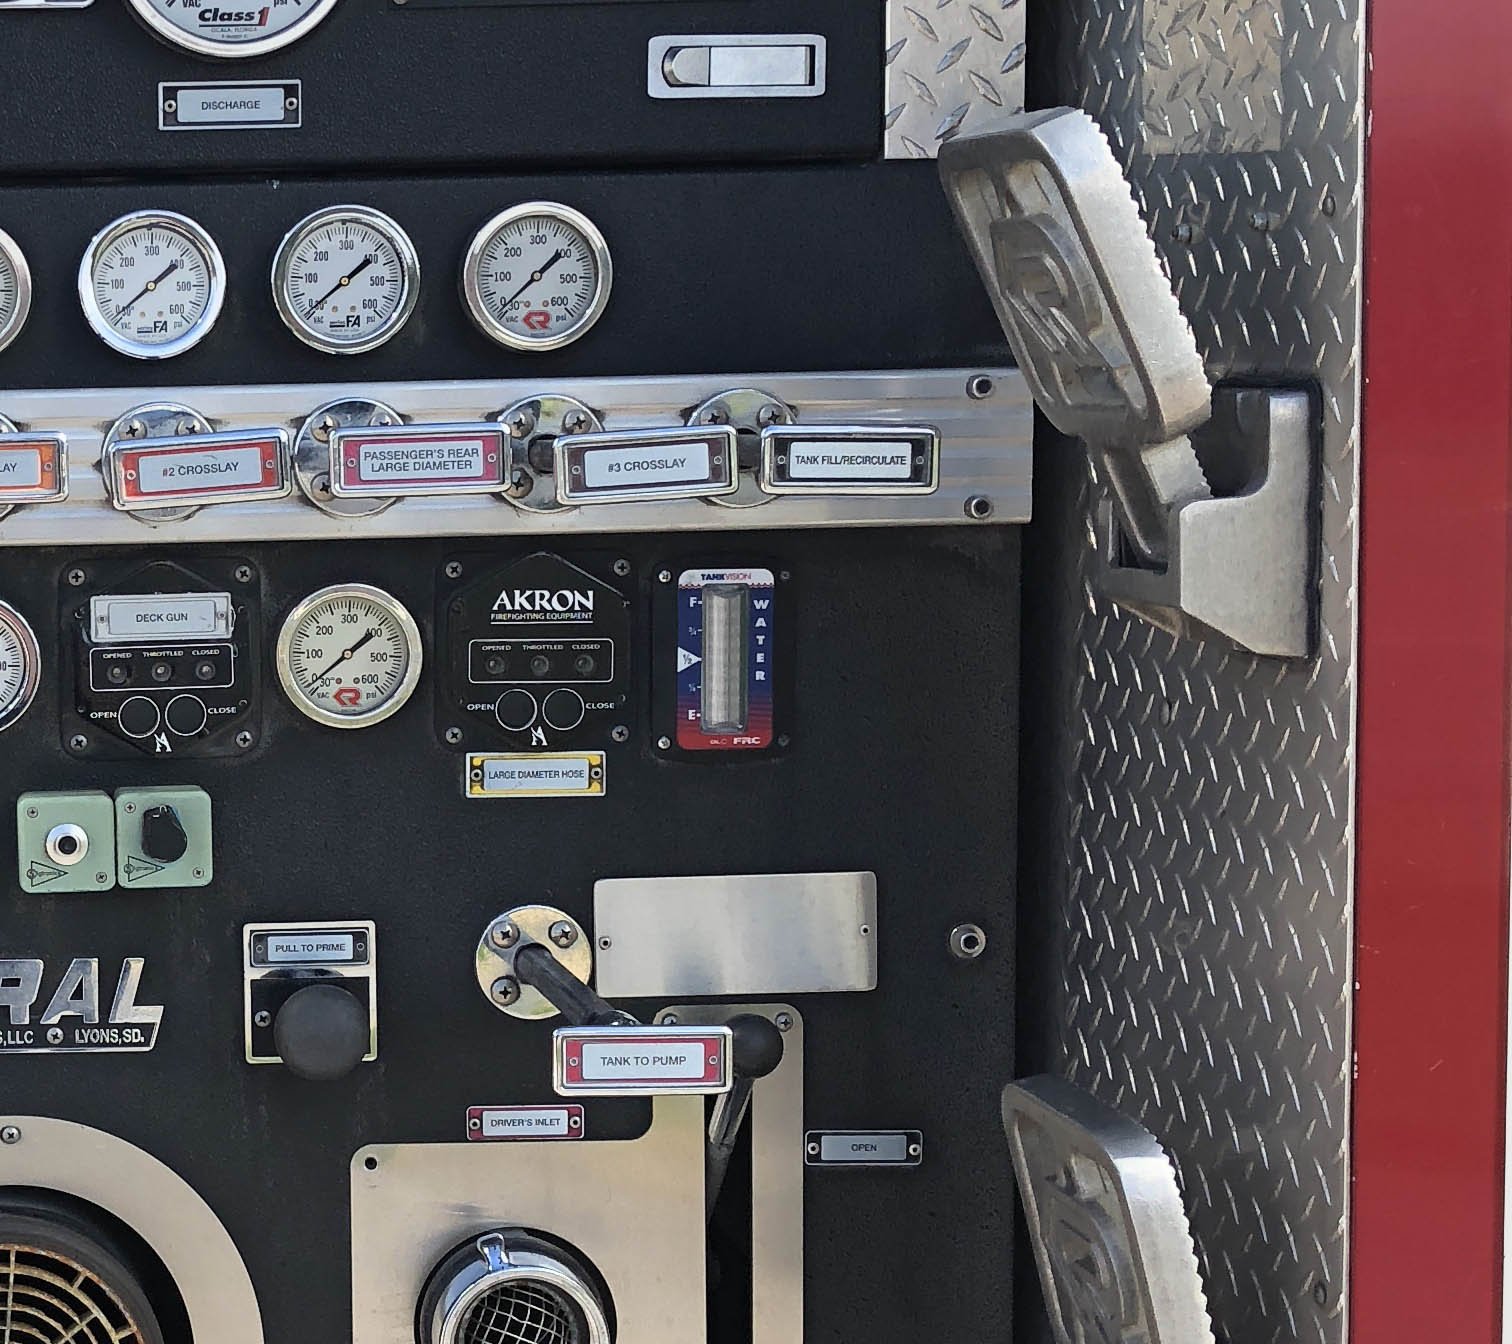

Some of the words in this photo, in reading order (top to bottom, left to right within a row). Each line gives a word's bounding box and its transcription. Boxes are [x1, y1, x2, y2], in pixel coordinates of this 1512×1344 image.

[199, 7, 270, 26] Class1
[201, 101, 261, 110] DISCHARGE
[529, 234, 547, 245] 300
[144, 246, 160, 256] 300
[363, 448, 446, 464] PASSENGER'S
[448, 447, 480, 460] REAR
[794, 455, 820, 466] TANK
[822, 455, 907, 466] FILL/RECIRCULATE
[162, 466, 175, 477] #2
[178, 462, 240, 476] CROSSLAY
[371, 461, 411, 474] LARGE
[412, 458, 473, 472] DIAMETER
[607, 462, 623, 473] #3
[625, 458, 687, 472] CROSSLAY
[492, 590, 593, 611] AKRON
[136, 614, 163, 622] DECK
[167, 613, 188, 621] GUN
[341, 614, 358, 624] 300
[546, 612, 593, 620] EQUIPMENT
[316, 626, 333, 635] 200
[489, 771, 516, 779] LARGE
[518, 770, 560, 779] DIAMETER
[562, 770, 585, 778] HOSE
[301, 944, 313, 952] TO
[600, 1056, 631, 1067] TANK
[634, 1056, 650, 1066] TO
[652, 1055, 687, 1066] PUMP
[490, 1118, 533, 1127] DRIVER'S
[534, 1118, 561, 1127] INLET
[851, 1144, 877, 1152] OPEN
